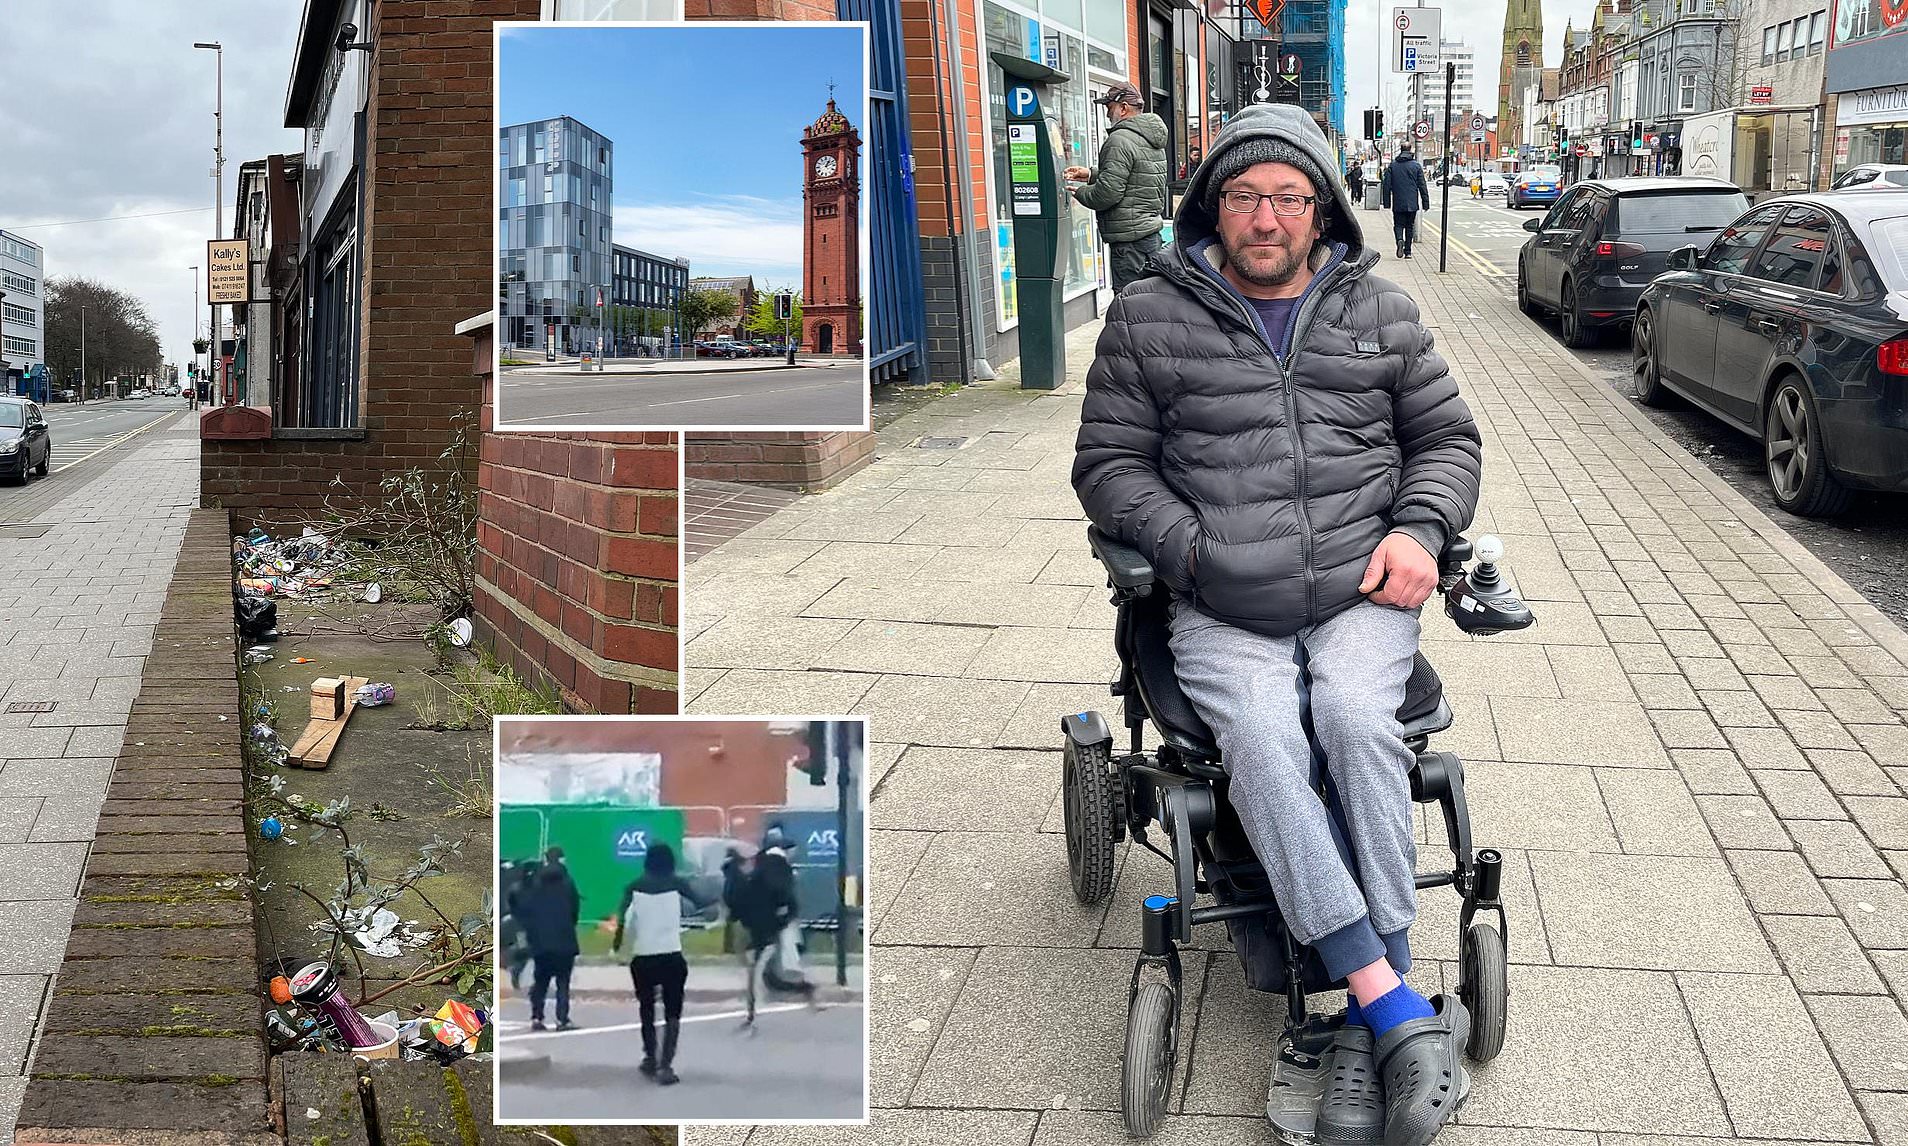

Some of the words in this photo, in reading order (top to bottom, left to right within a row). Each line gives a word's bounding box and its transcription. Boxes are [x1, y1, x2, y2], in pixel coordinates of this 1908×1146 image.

[1016, 87, 1034, 115] P
[1417, 126, 1428, 134] 20
[213, 248, 241, 261] Kally's
[211, 264, 232, 272] Cakes
[233, 263, 245, 271] Ltd.
